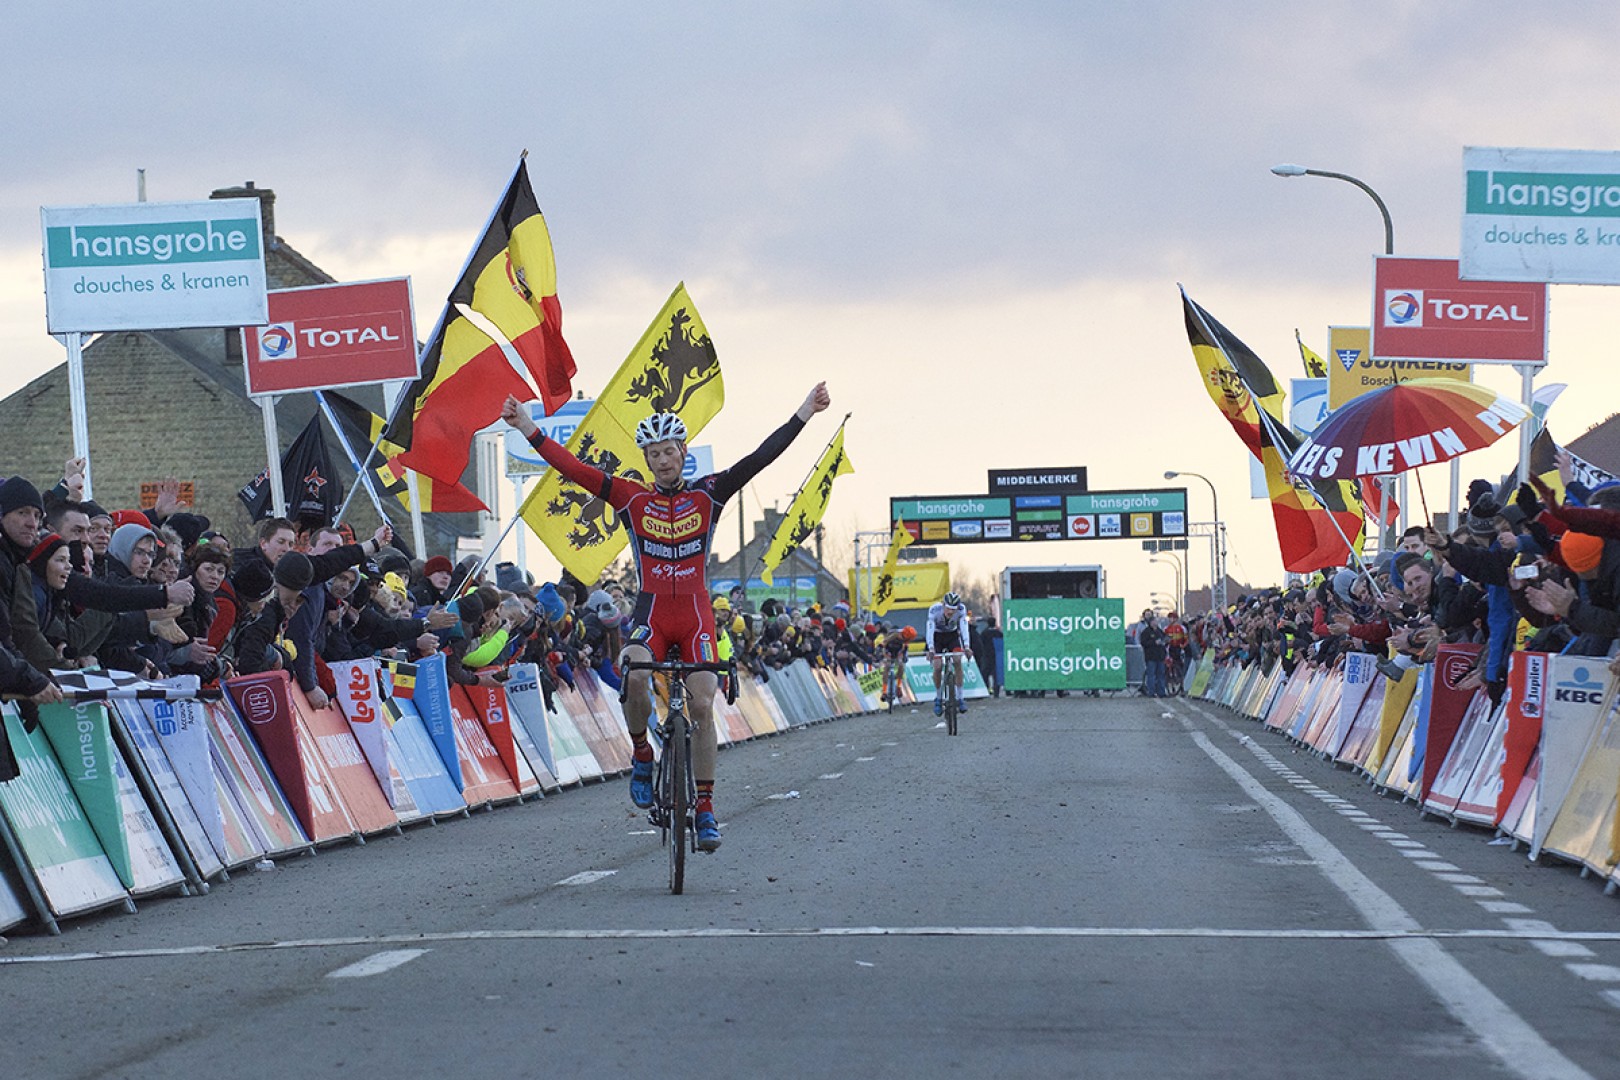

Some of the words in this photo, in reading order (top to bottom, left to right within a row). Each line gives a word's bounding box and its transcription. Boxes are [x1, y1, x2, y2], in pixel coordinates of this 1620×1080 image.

[71, 219, 247, 261] hansgrohe
[1485, 225, 1567, 246] douches
[1574, 227, 1589, 245] &
[74, 275, 154, 294] douches
[161, 274, 175, 290] &
[182, 271, 249, 289] kranen
[1428, 299, 1528, 321] TOTAL
[300, 326, 399, 348] TOTAL
[1356, 427, 1467, 475] KEVIN
[997, 474, 1078, 486] MIDDELKERKE
[917, 499, 985, 516] hansgrohe
[1090, 494, 1159, 510] hansgrohe
[646, 515, 699, 535] Sunweb
[1006, 608, 1122, 634] hansgrohe
[1007, 648, 1123, 673] hansgrohe
[509, 682, 538, 693] KBC
[1528, 658, 1541, 701] Jupiler
[248, 690, 271, 718] VIER
[487, 687, 497, 709] TOT
[1555, 689, 1603, 705] KBC
